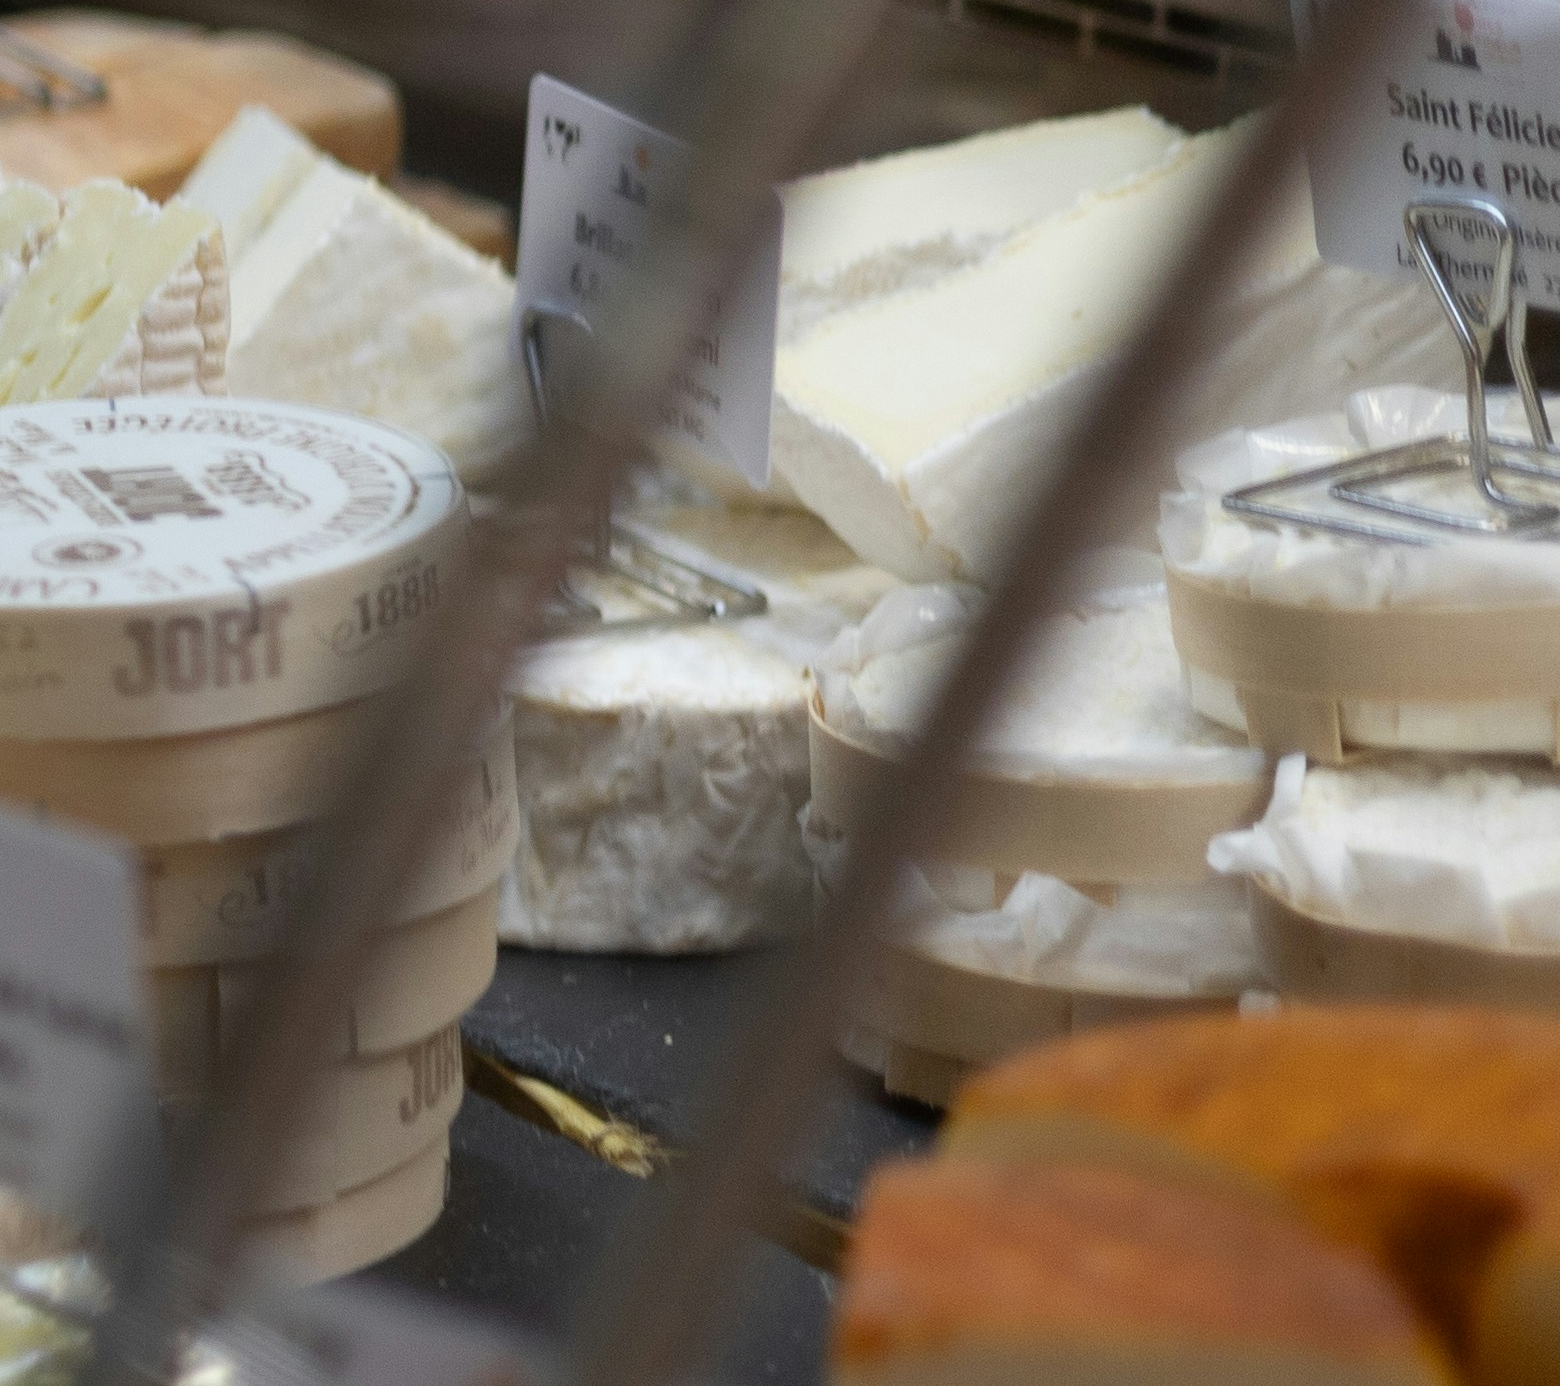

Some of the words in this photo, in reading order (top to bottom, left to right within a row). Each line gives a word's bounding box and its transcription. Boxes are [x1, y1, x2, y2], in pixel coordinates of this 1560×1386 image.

[1386, 82, 1462, 132] Saint
[1402, 140, 1465, 188] 6,90
[1472, 161, 1488, 190] €
[113, 600, 290, 698] JORT
[398, 1021, 458, 1126] JOR
